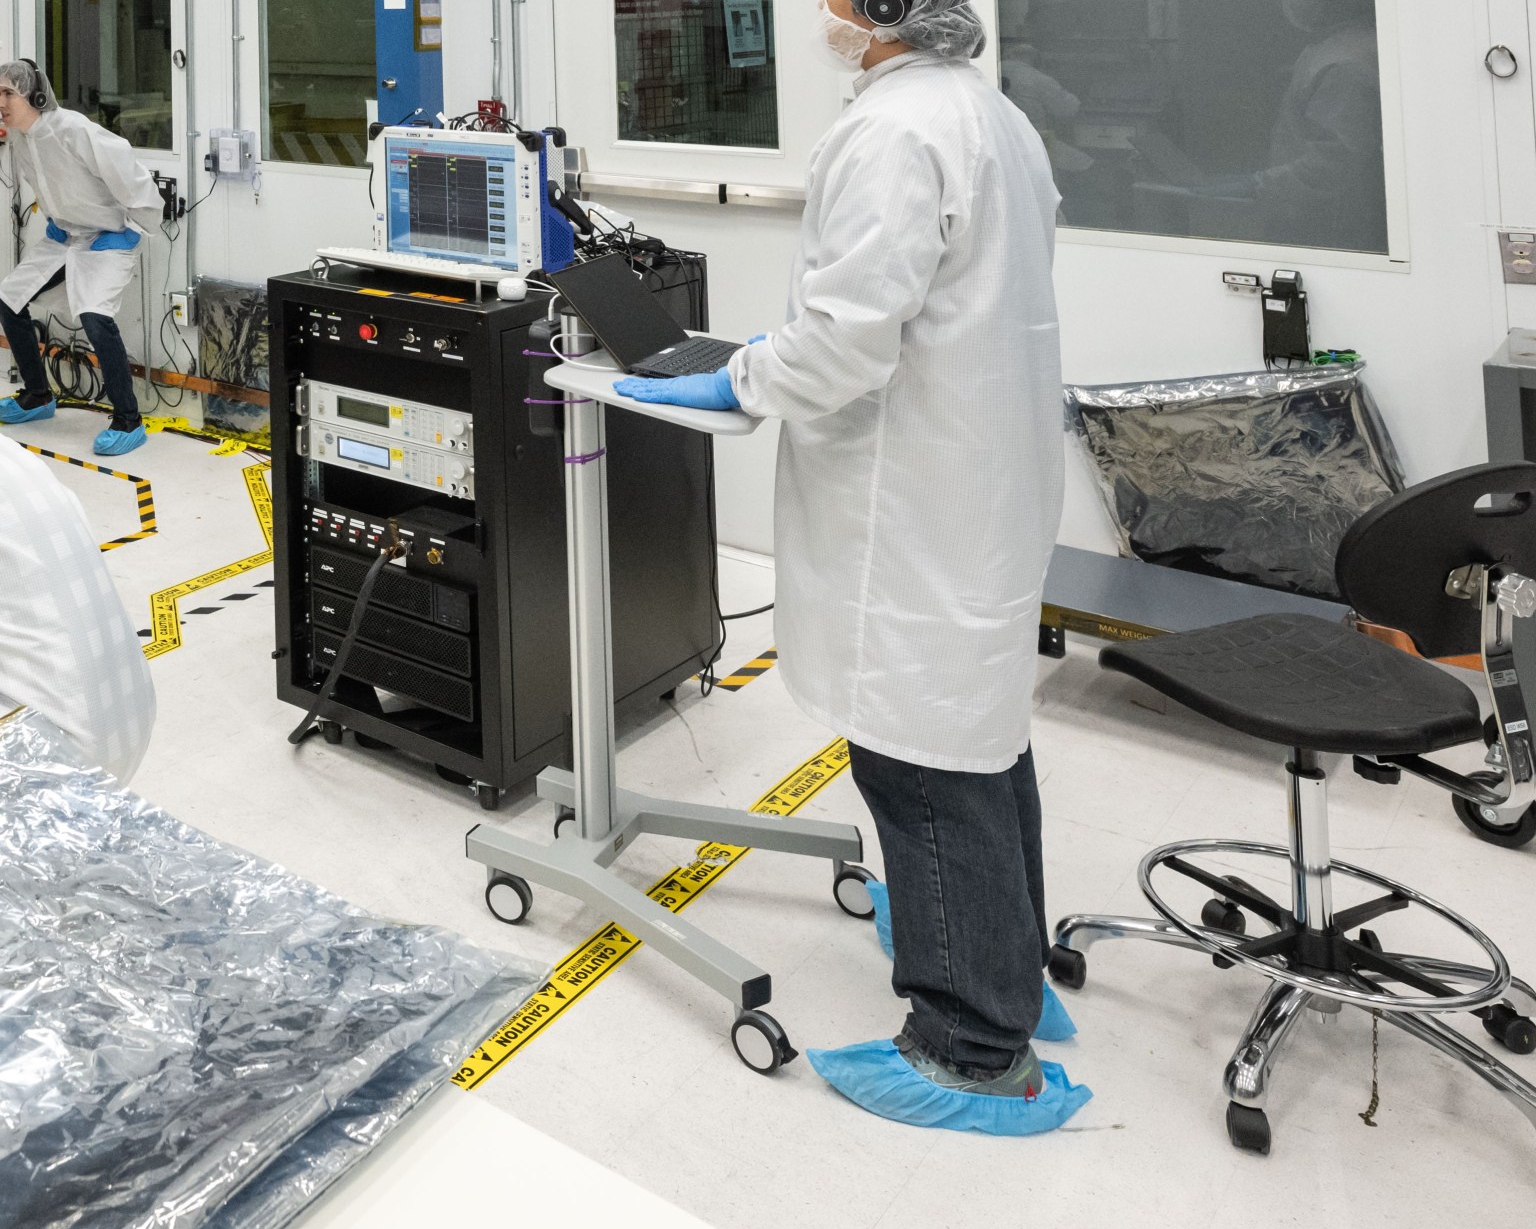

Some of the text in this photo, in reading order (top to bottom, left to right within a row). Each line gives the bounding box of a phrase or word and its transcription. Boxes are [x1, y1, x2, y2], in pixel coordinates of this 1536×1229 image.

[197, 568, 232, 583] CAUTION
[321, 564, 334, 573] APC
[322, 606, 335, 614] APC
[159, 614, 168, 635] CAUTION
[324, 647, 336, 656] APC
[789, 772, 824, 798] CAUTION
[556, 942, 606, 981] STATIC SENSITIVE AREA
[567, 948, 616, 986] CAUTION
[520, 998, 539, 1012] STATIC
[495, 1004, 550, 1047] CAUTION
